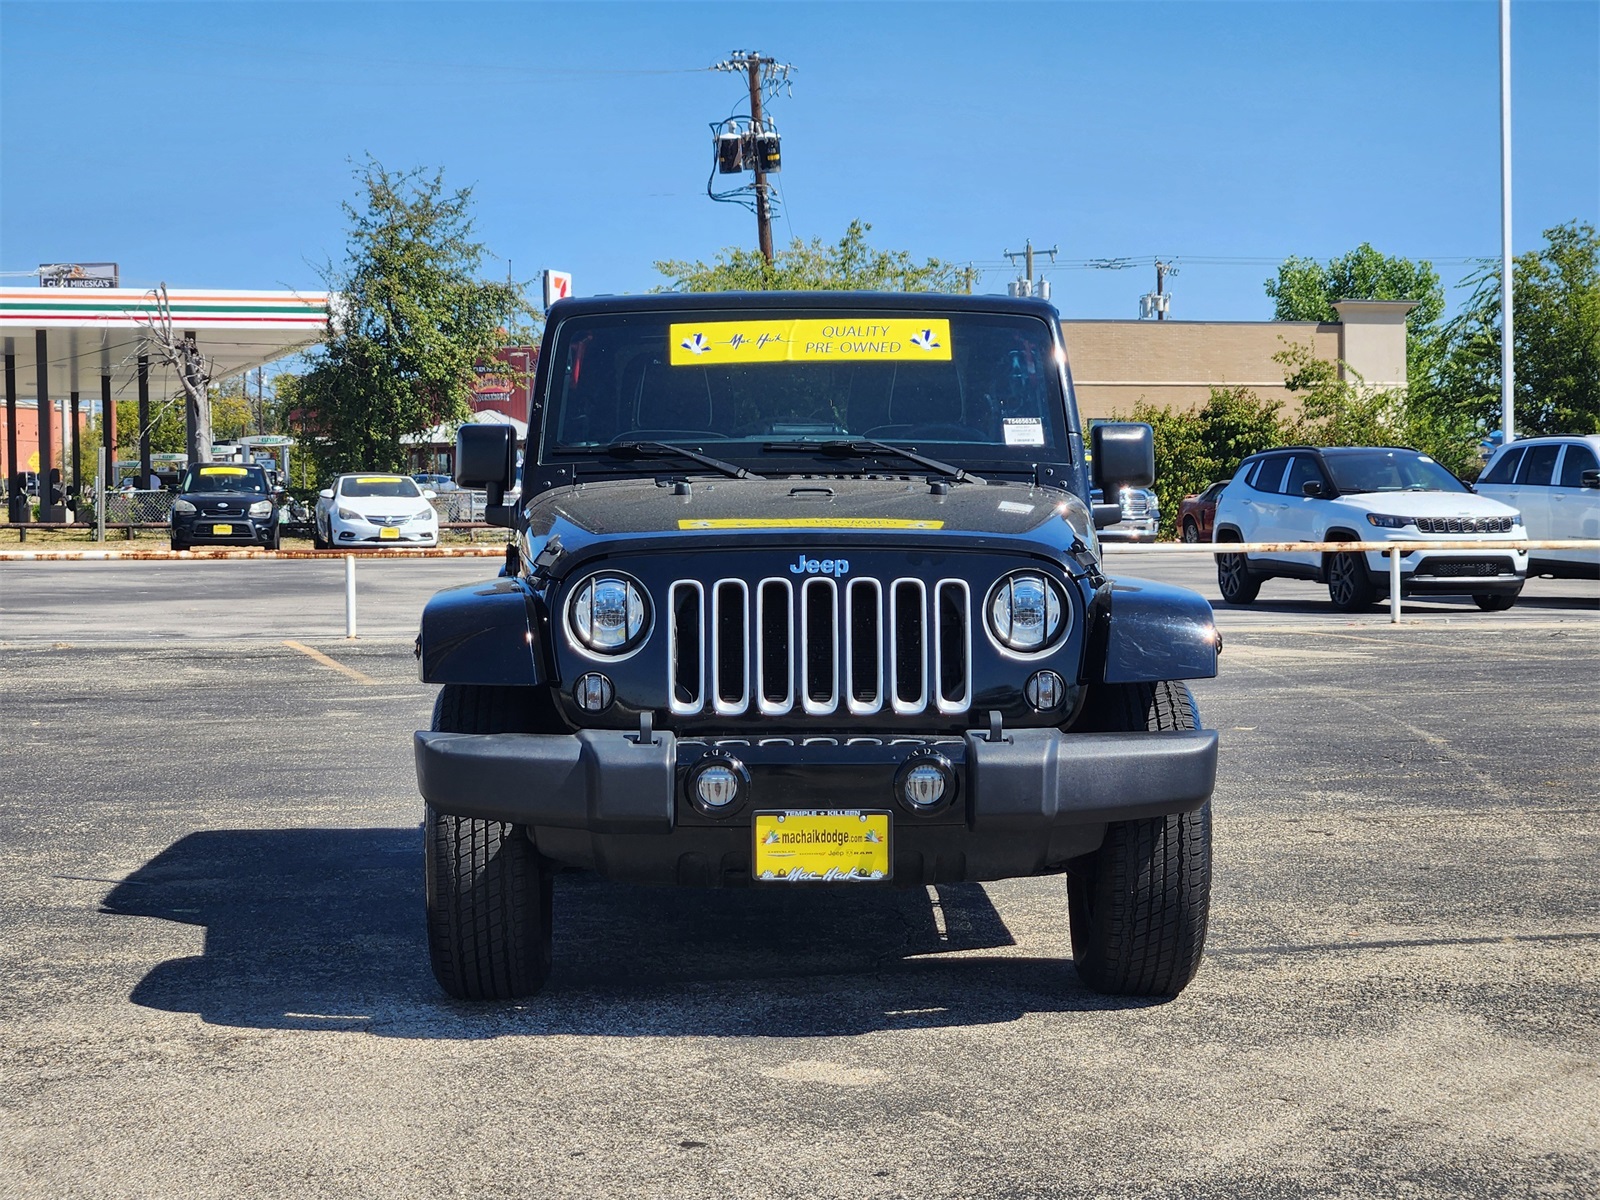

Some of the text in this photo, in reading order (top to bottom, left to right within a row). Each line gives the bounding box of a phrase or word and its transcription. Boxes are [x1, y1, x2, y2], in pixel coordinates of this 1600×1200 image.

[70, 280, 110, 288] MIKESKA'S
[822, 325, 890, 338] QUALITY
[729, 332, 783, 350] Mac Haik
[805, 341, 901, 353] PRE-OWNED
[789, 554, 849, 577] Jeep
[781, 829, 863, 846] machaikdodge.com
[784, 866, 862, 881] Mac Haik
